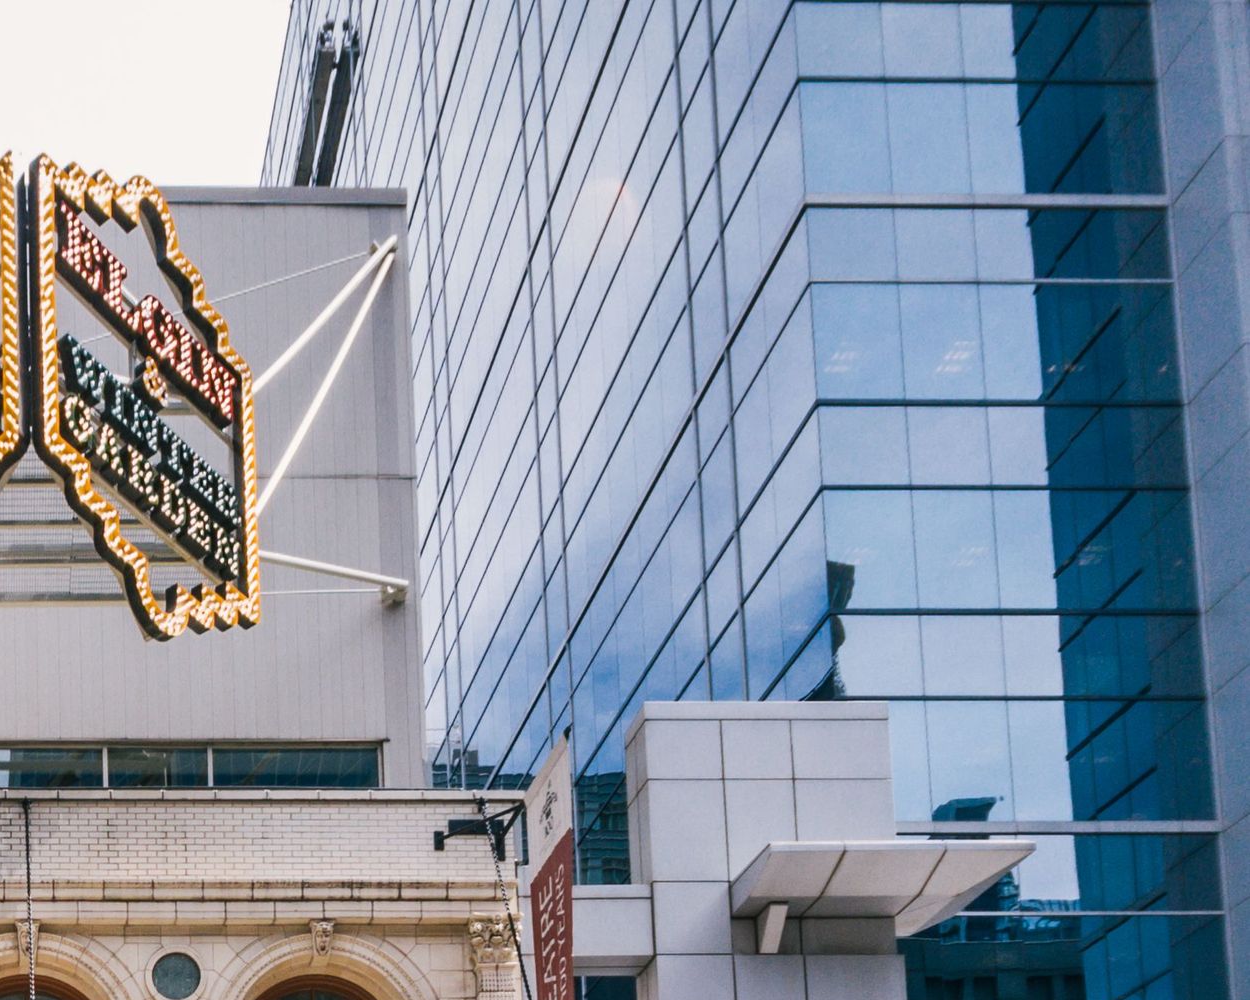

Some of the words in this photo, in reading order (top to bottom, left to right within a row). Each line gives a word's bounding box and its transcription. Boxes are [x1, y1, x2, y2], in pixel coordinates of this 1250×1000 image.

[59, 200, 237, 423] ELGIN
[64, 394, 240, 577] GARDEN
[67, 335, 241, 525] WINTER
[554, 864, 566, 955] YEARS
